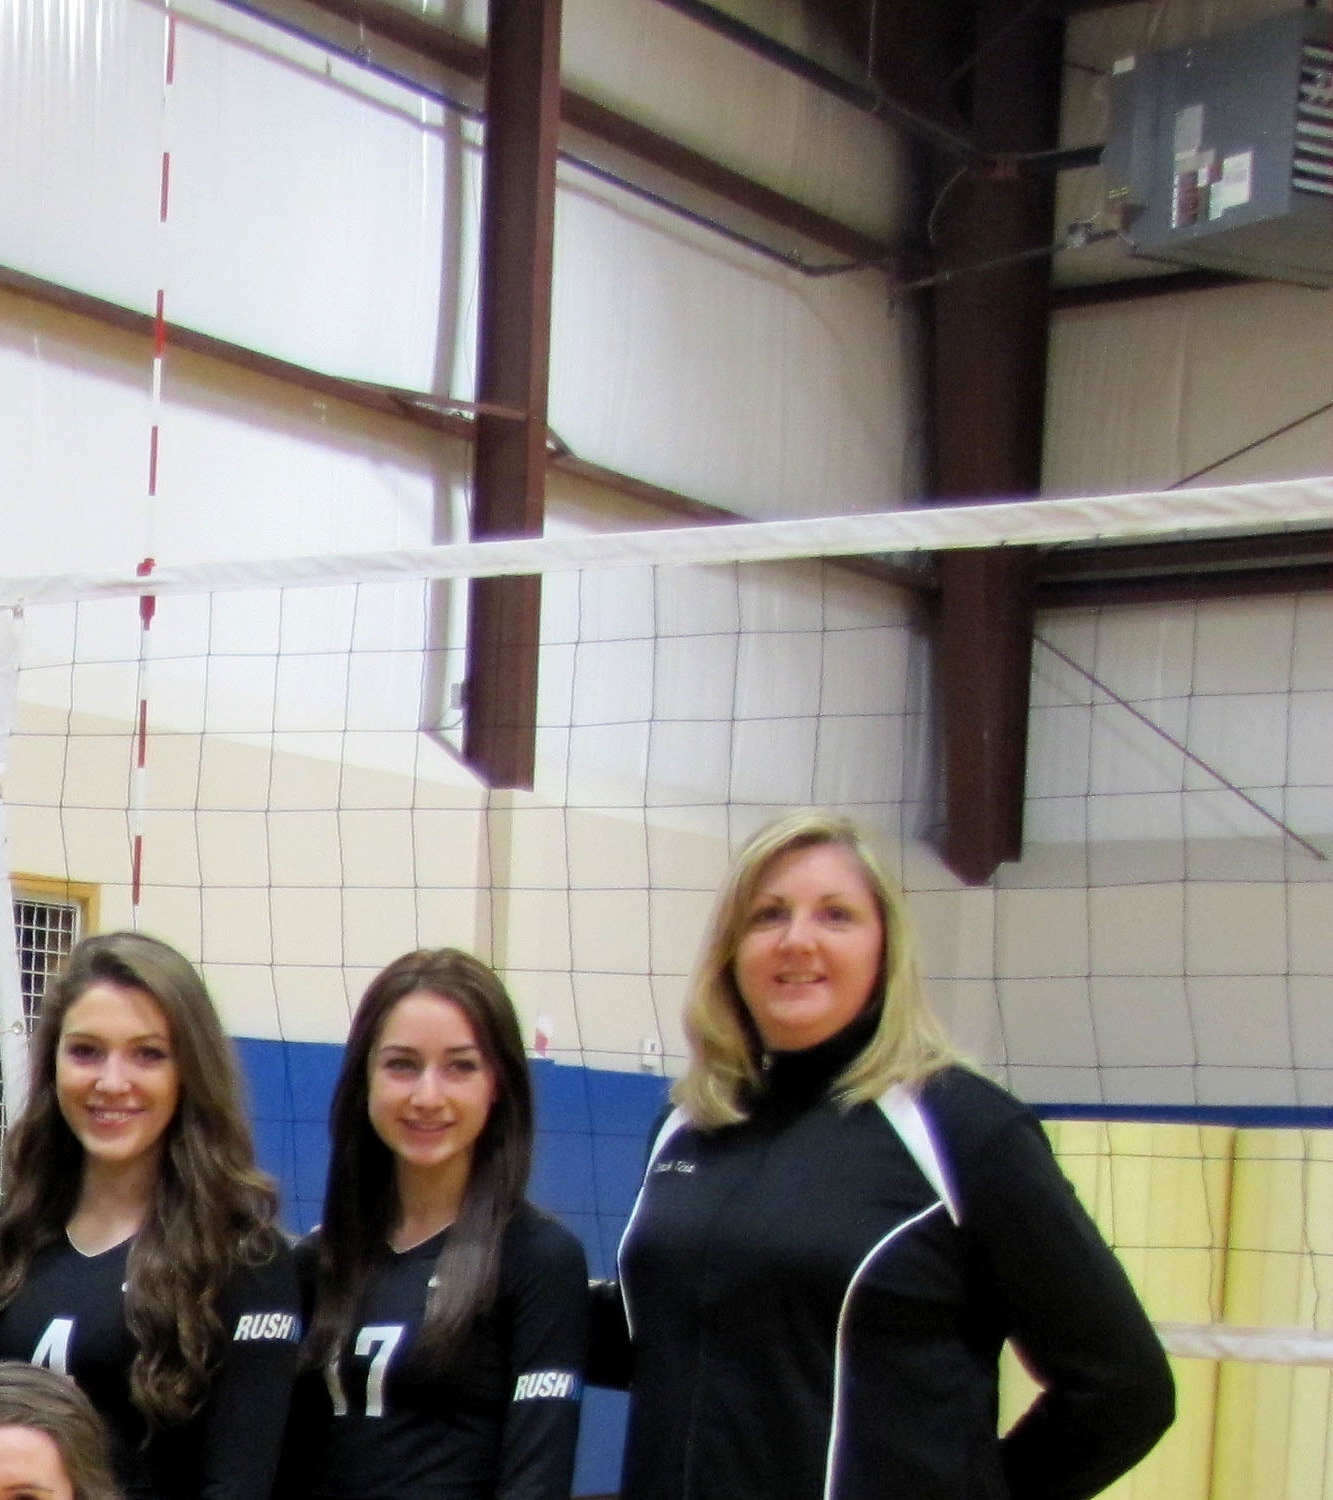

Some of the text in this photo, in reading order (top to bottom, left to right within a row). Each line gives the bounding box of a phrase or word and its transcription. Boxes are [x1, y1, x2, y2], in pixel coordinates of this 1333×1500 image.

[233, 1313, 294, 1341] RUSH
[31, 1318, 73, 1376] 4
[513, 1372, 571, 1402] RUSH
